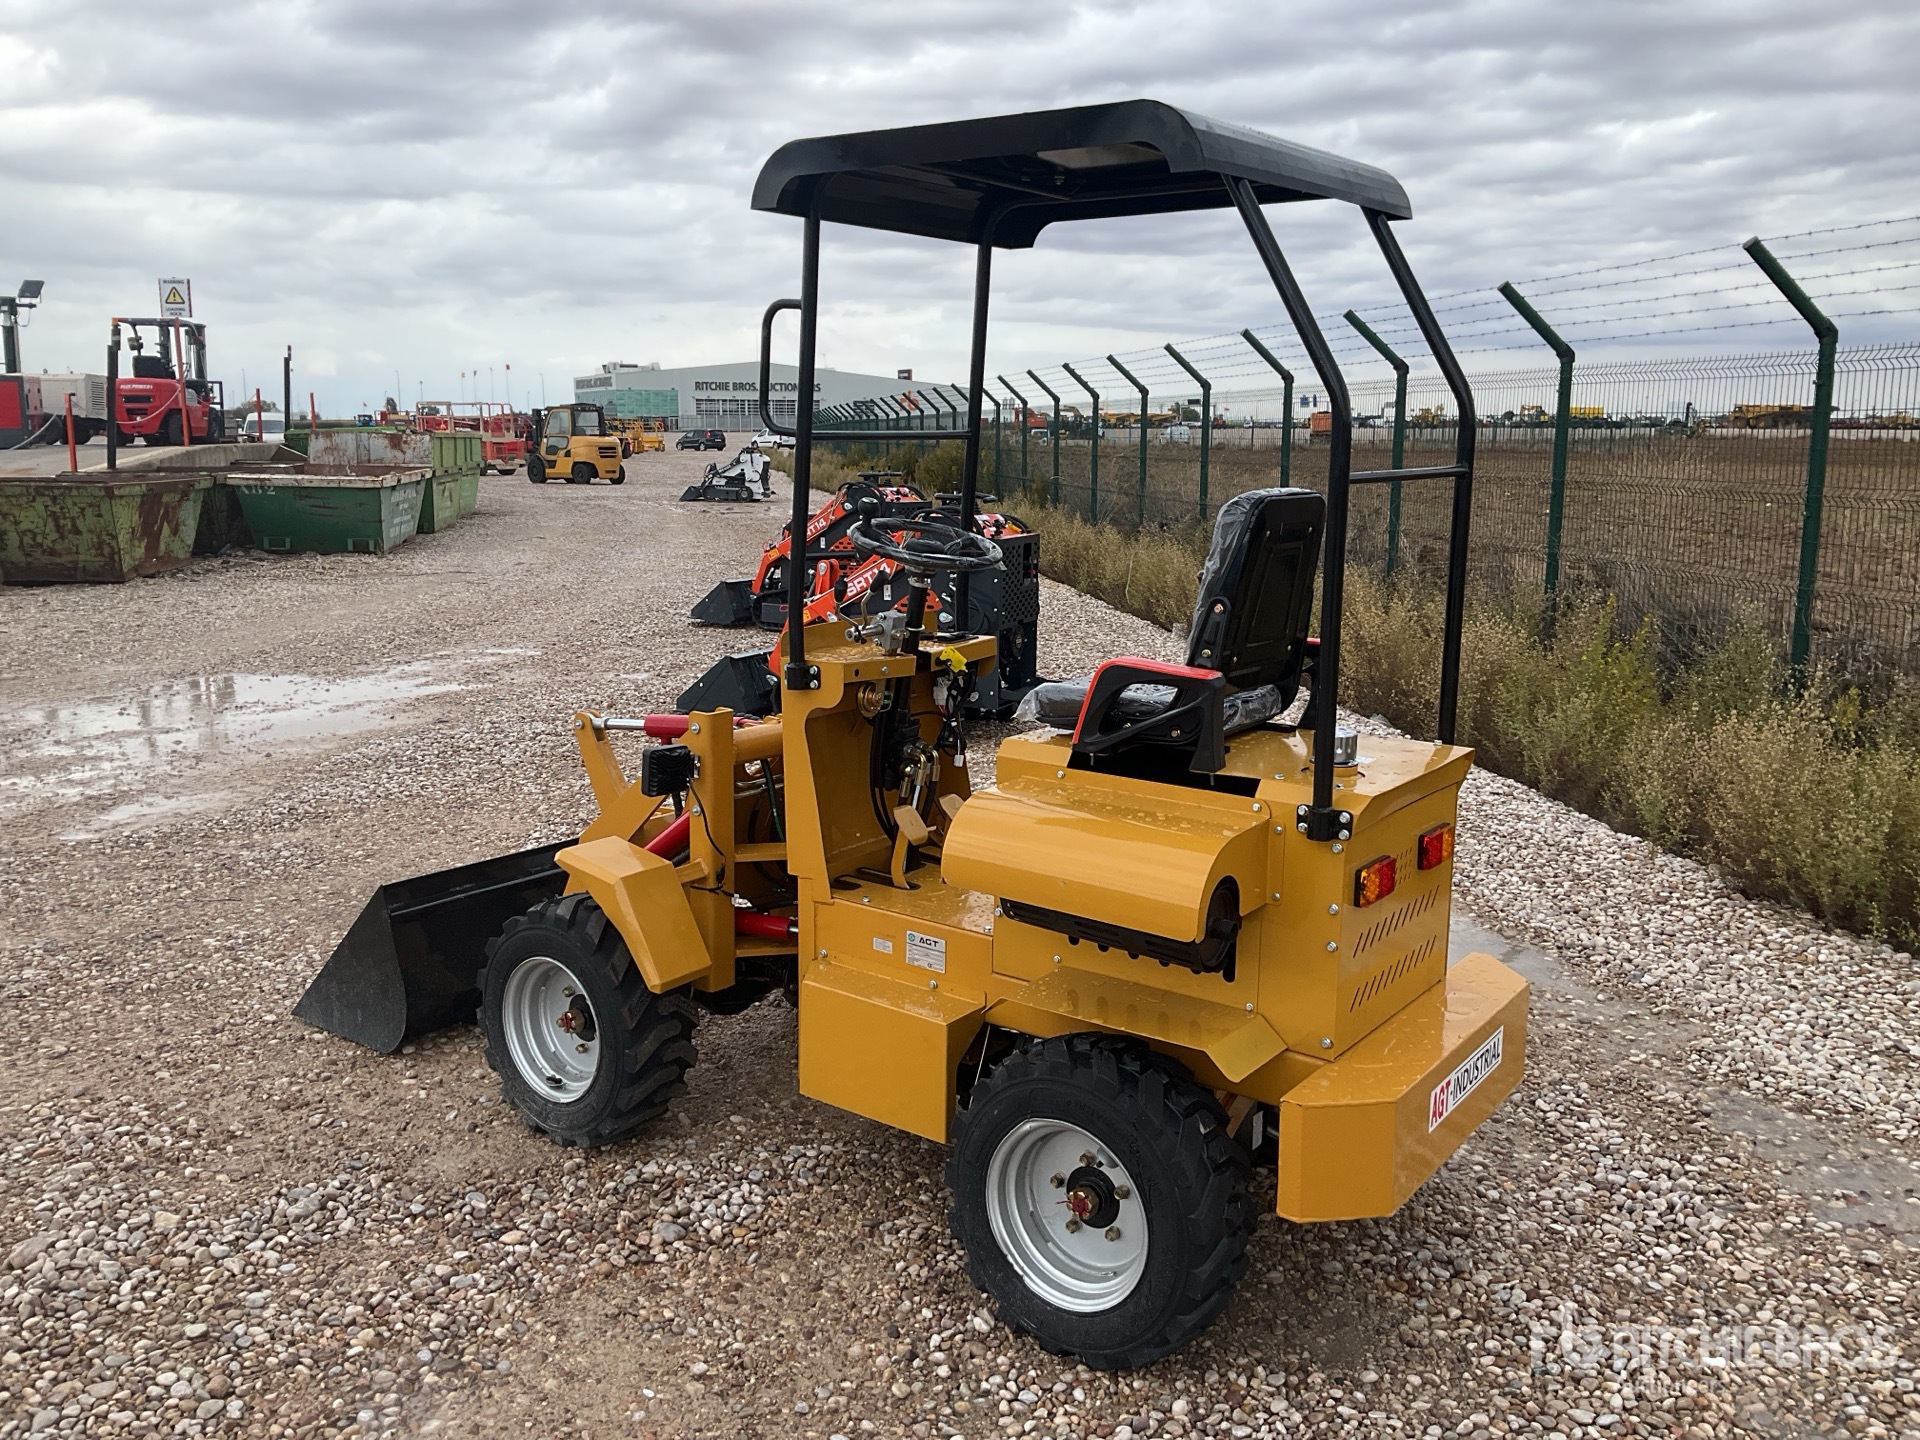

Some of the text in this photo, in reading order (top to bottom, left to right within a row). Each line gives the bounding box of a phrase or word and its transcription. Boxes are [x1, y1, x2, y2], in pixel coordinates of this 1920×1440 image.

[694, 381, 730, 391] RITCHIE
[732, 382, 759, 392] BROS.
[919, 936, 939, 947] AGT
